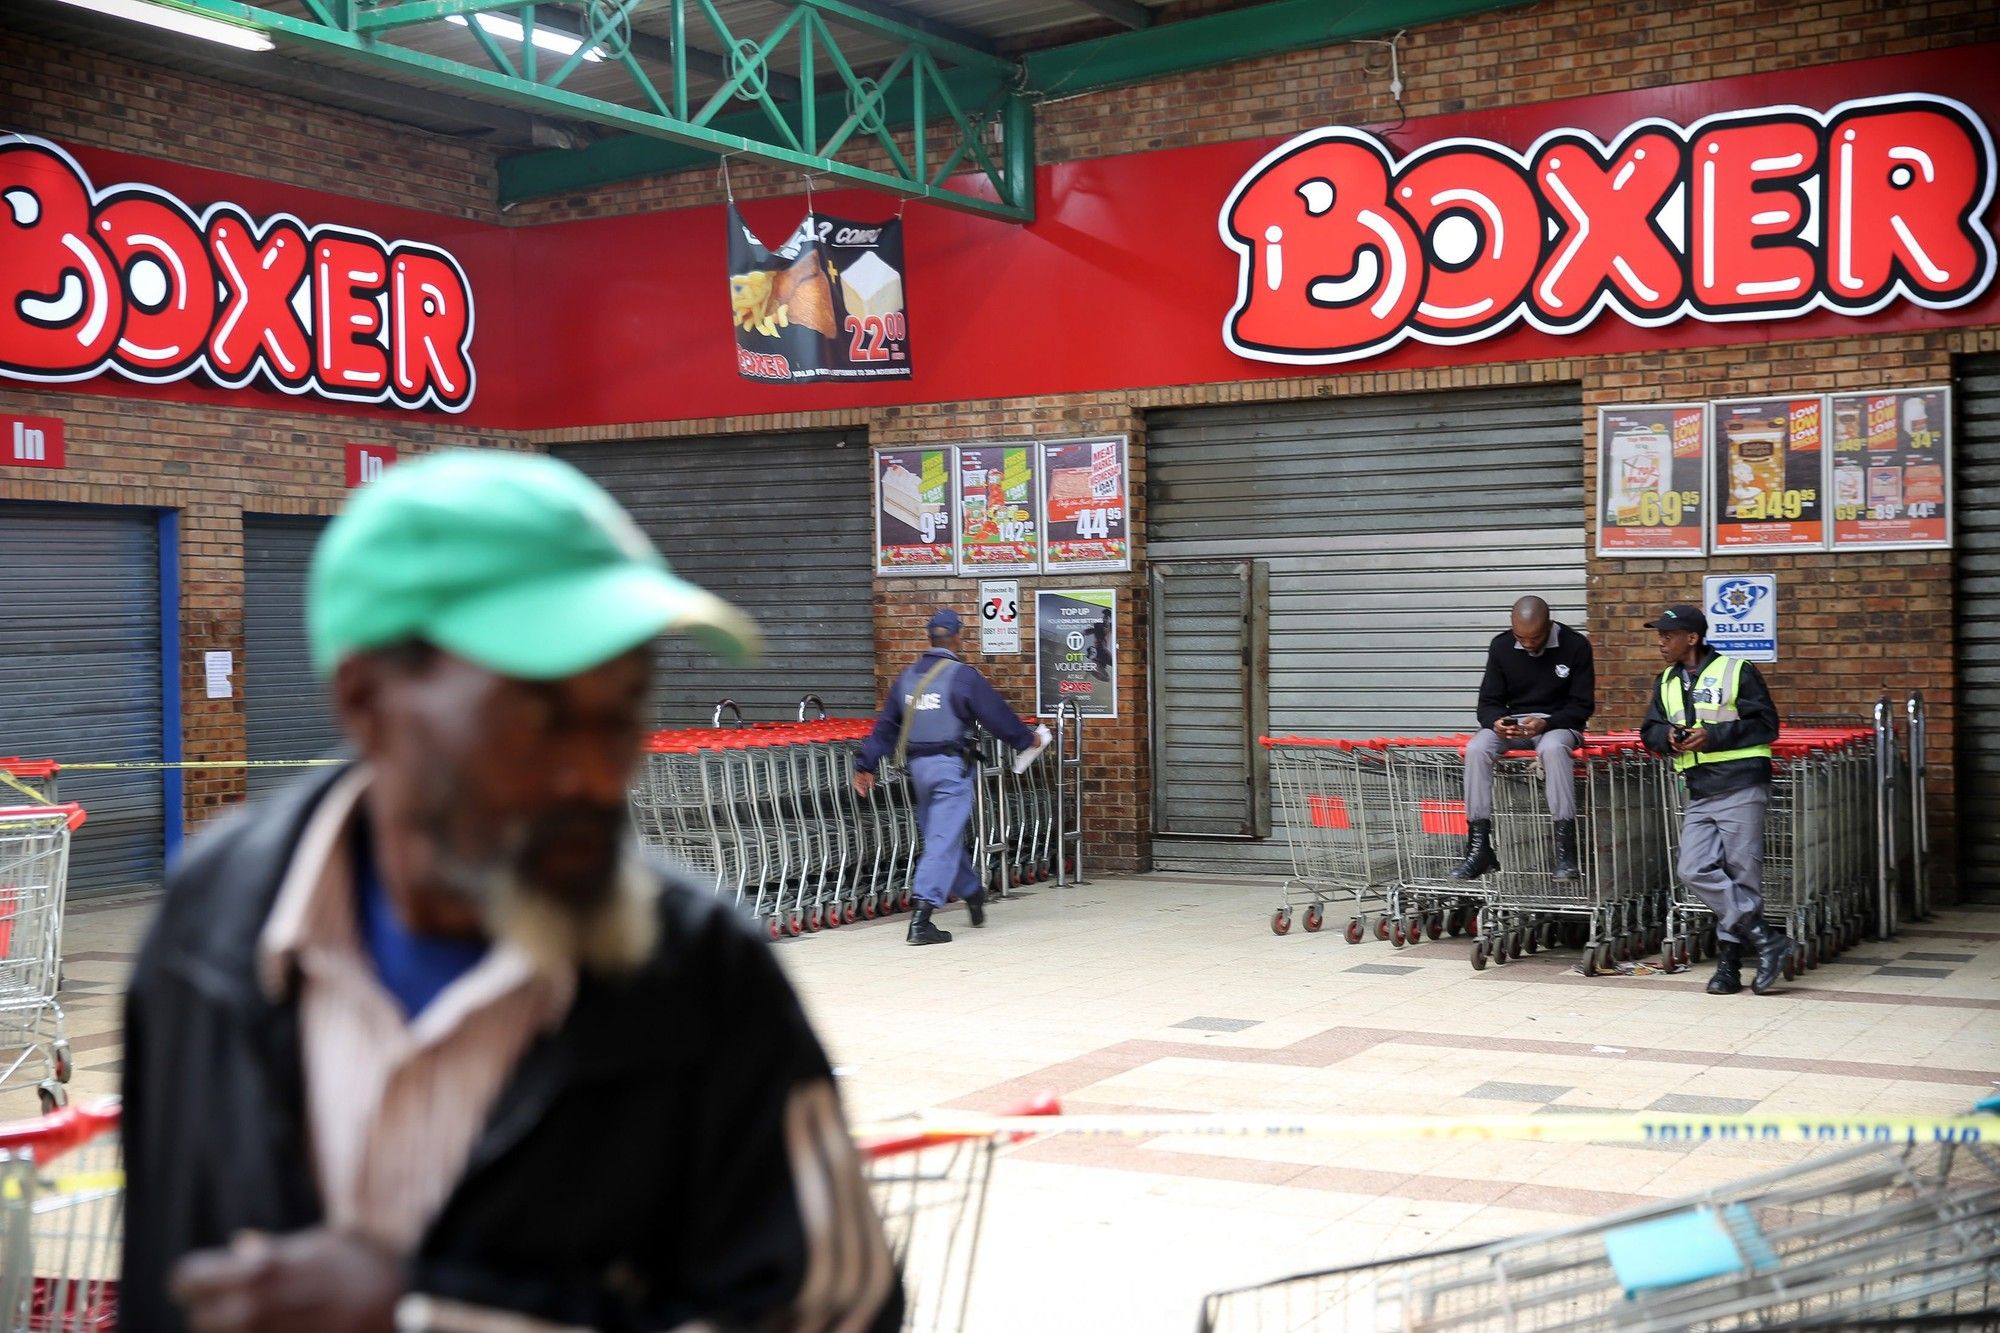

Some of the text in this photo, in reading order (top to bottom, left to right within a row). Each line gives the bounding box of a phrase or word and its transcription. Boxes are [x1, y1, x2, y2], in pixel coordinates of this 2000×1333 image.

[1219, 93, 1997, 364] BOXER
[0, 133, 475, 413] BOXER
[845, 314, 890, 362] 22
[736, 346, 792, 379] OXER
[1790, 405, 1818, 420] LOW
[1868, 396, 1897, 413] LOW
[1673, 413, 1700, 428] LOW
[1790, 413, 1818, 434] LOW
[1868, 405, 1897, 426] LOW
[1673, 422, 1700, 440] LOW
[1790, 427, 1818, 441] LOW
[1868, 419, 1897, 436] LOW
[13, 421, 45, 460] In
[1673, 434, 1700, 449] LOW
[360, 450, 384, 482] In
[1640, 490, 1682, 526] 69
[920, 512, 936, 543] 9
[1076, 508, 1121, 539] 44 95
[1060, 608, 1090, 616] TOP UP
[1715, 623, 1765, 633] BLUE
[1066, 652, 1086, 662] OTT
[1054, 662, 1098, 672] VOUCHER
[904, 693, 941, 710] PLICE
